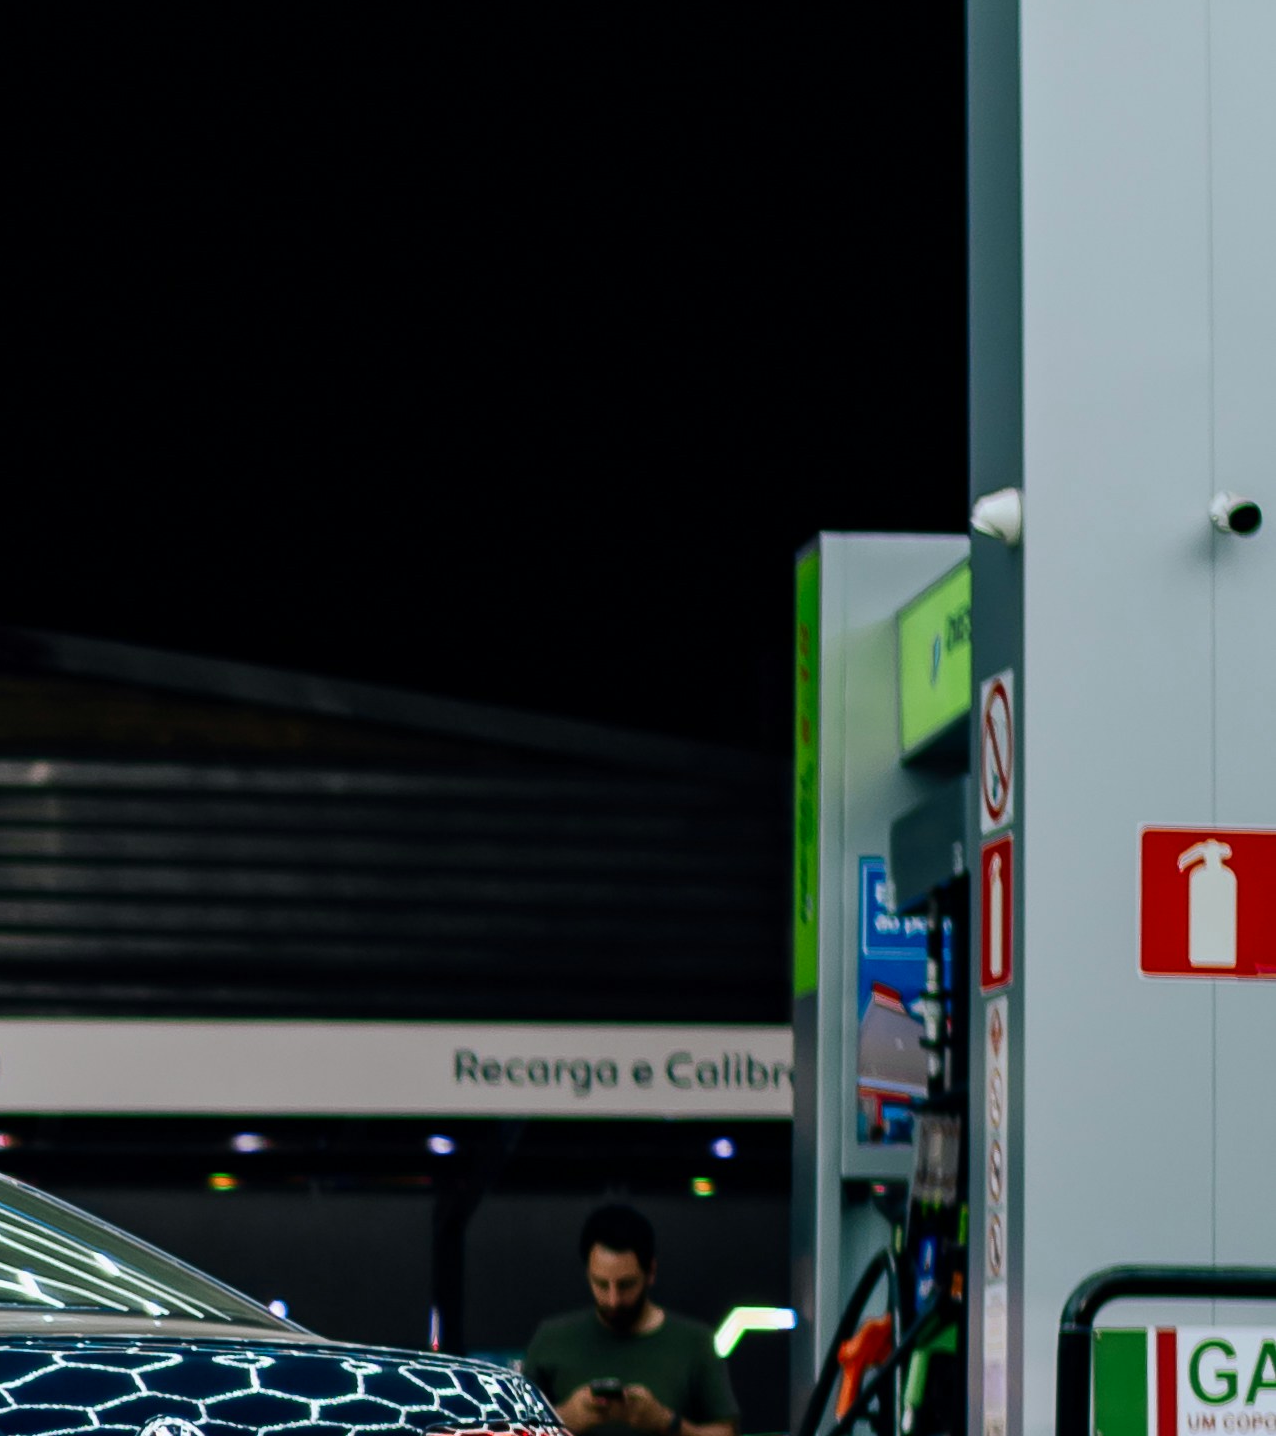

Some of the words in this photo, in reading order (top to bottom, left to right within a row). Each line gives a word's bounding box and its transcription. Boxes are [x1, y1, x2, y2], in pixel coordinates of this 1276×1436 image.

[454, 1048, 619, 1098] Recarga
[632, 1059, 654, 1089] e
[665, 1050, 794, 1090] Calibr
[1187, 1413, 1217, 1434] UM
